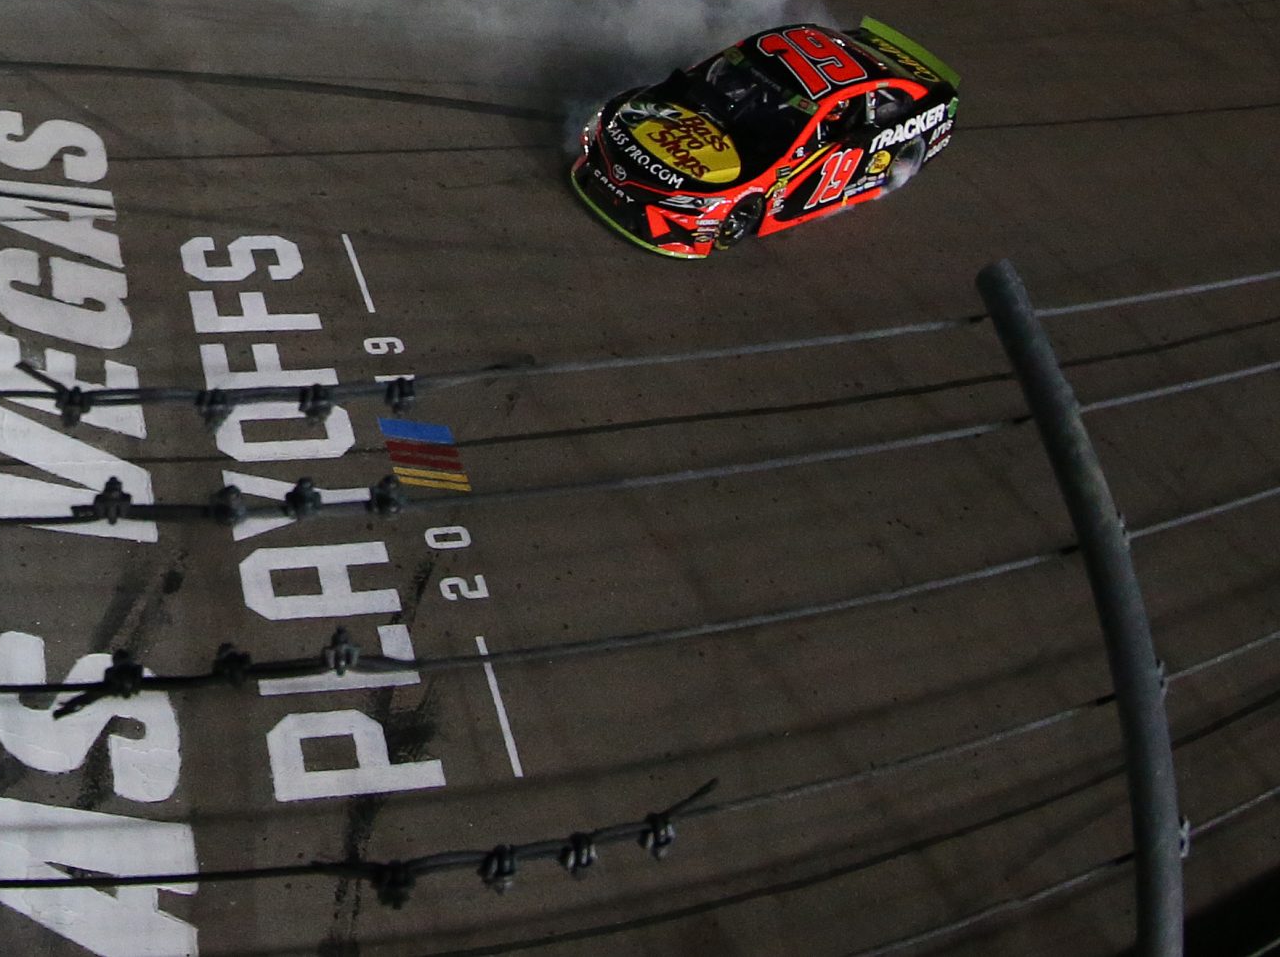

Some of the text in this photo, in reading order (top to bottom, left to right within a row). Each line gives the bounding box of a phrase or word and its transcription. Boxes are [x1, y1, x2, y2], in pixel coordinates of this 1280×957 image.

[757, 26, 868, 100] 19
[678, 115, 730, 152] Bass
[869, 103, 945, 154] TRACKER
[624, 144, 684, 189] PRO.COM
[646, 129, 710, 179] Shops
[803, 148, 864, 210] 19
[594, 169, 635, 203] CAMRY
[180, 234, 447, 802] PLAYOFFS
